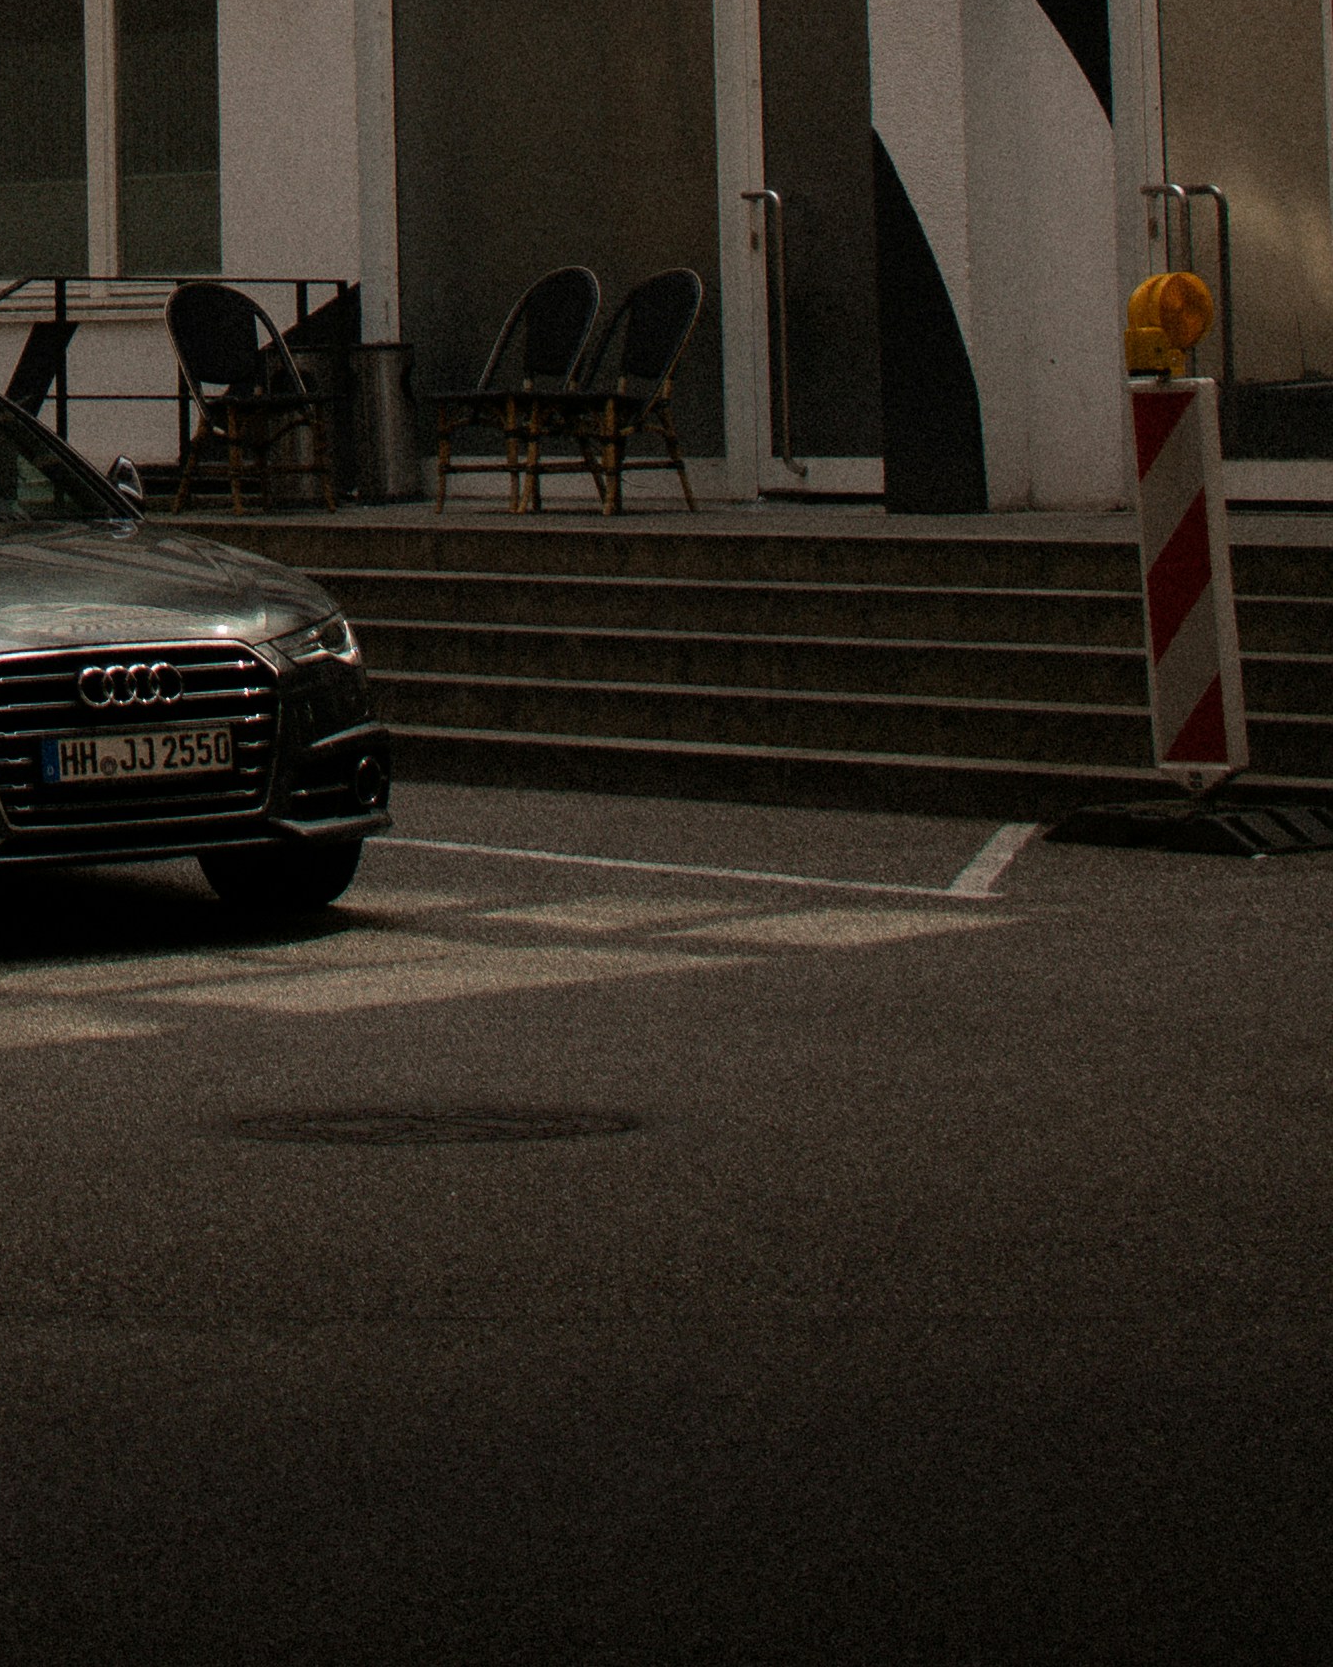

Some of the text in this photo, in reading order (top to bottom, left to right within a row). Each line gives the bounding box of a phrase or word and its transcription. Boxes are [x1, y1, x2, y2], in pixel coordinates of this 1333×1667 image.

[60, 740, 98, 776] HH
[119, 737, 155, 771] JJ
[162, 732, 230, 769] 2550
